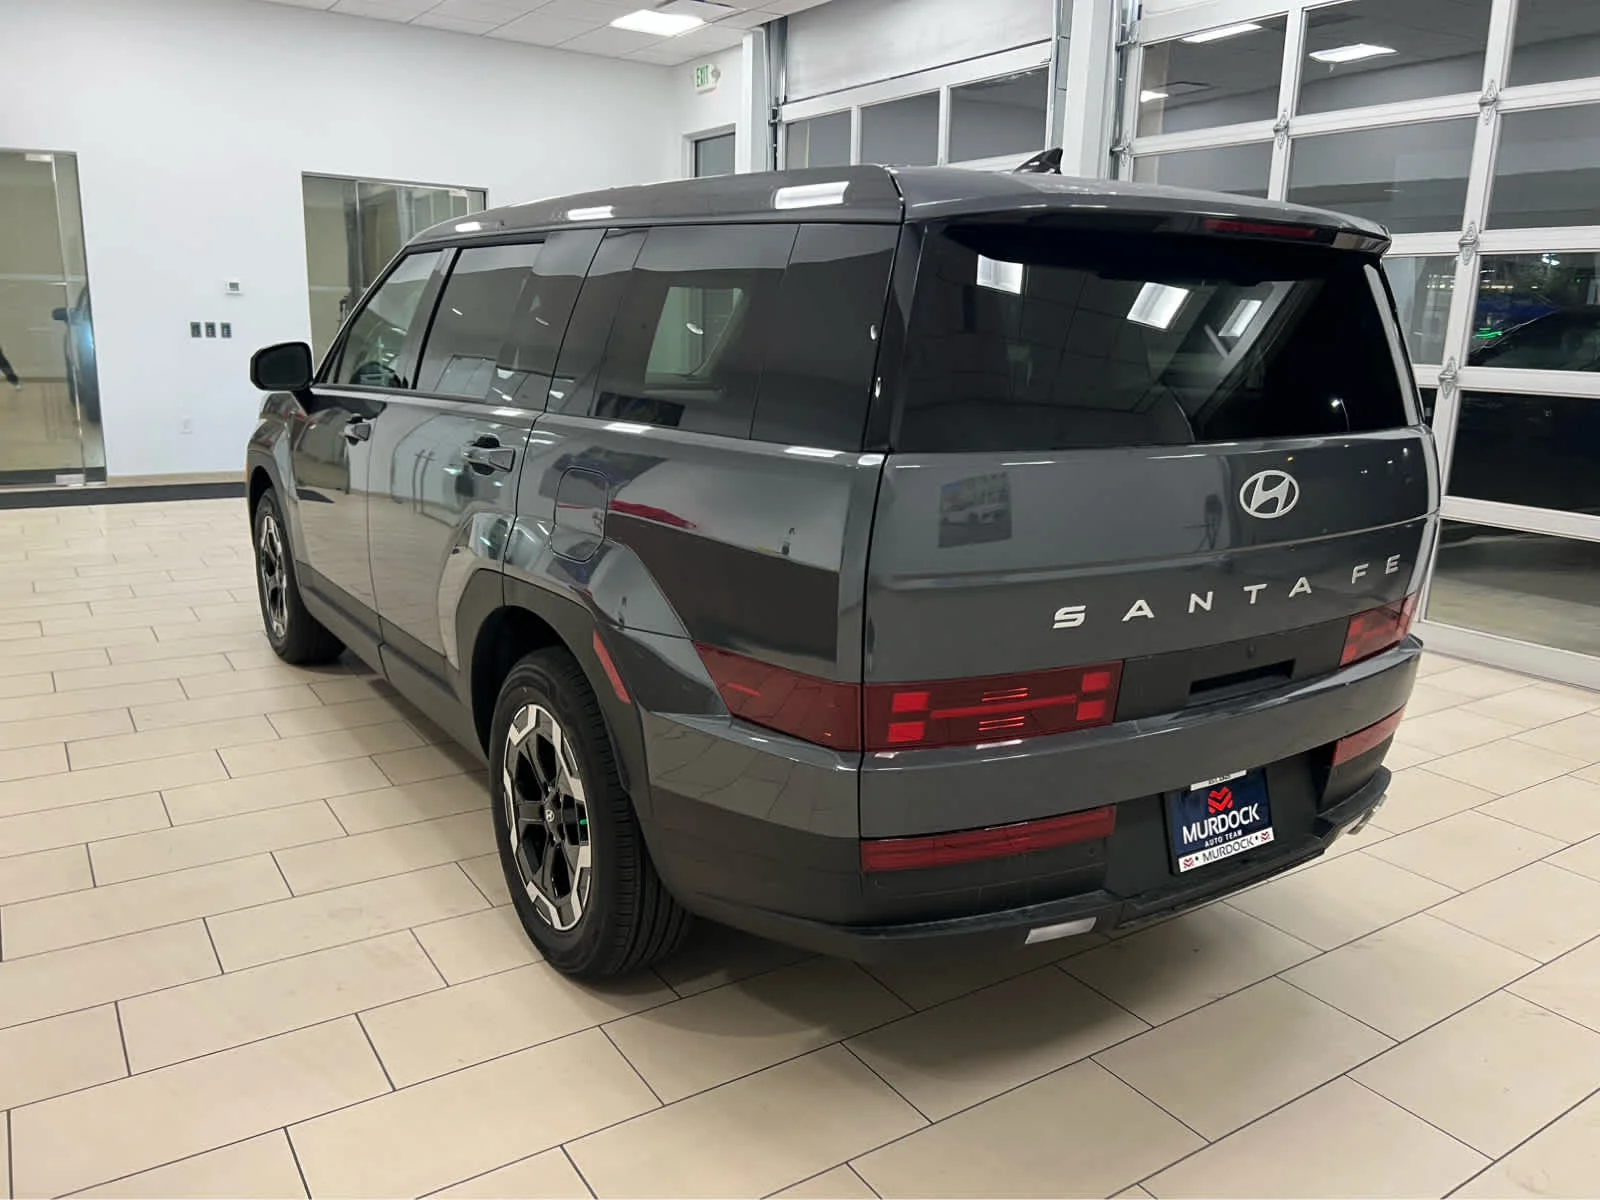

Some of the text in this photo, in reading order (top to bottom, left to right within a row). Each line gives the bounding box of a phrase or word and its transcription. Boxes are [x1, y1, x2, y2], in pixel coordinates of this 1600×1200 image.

[696, 65, 709, 88] EXIT
[1053, 554, 1400, 629] SANTA FE
[1182, 803, 1260, 844] MURDOCK
[1202, 837, 1255, 862] MURDOCK
[1204, 829, 1243, 848] AUTO TEAM
